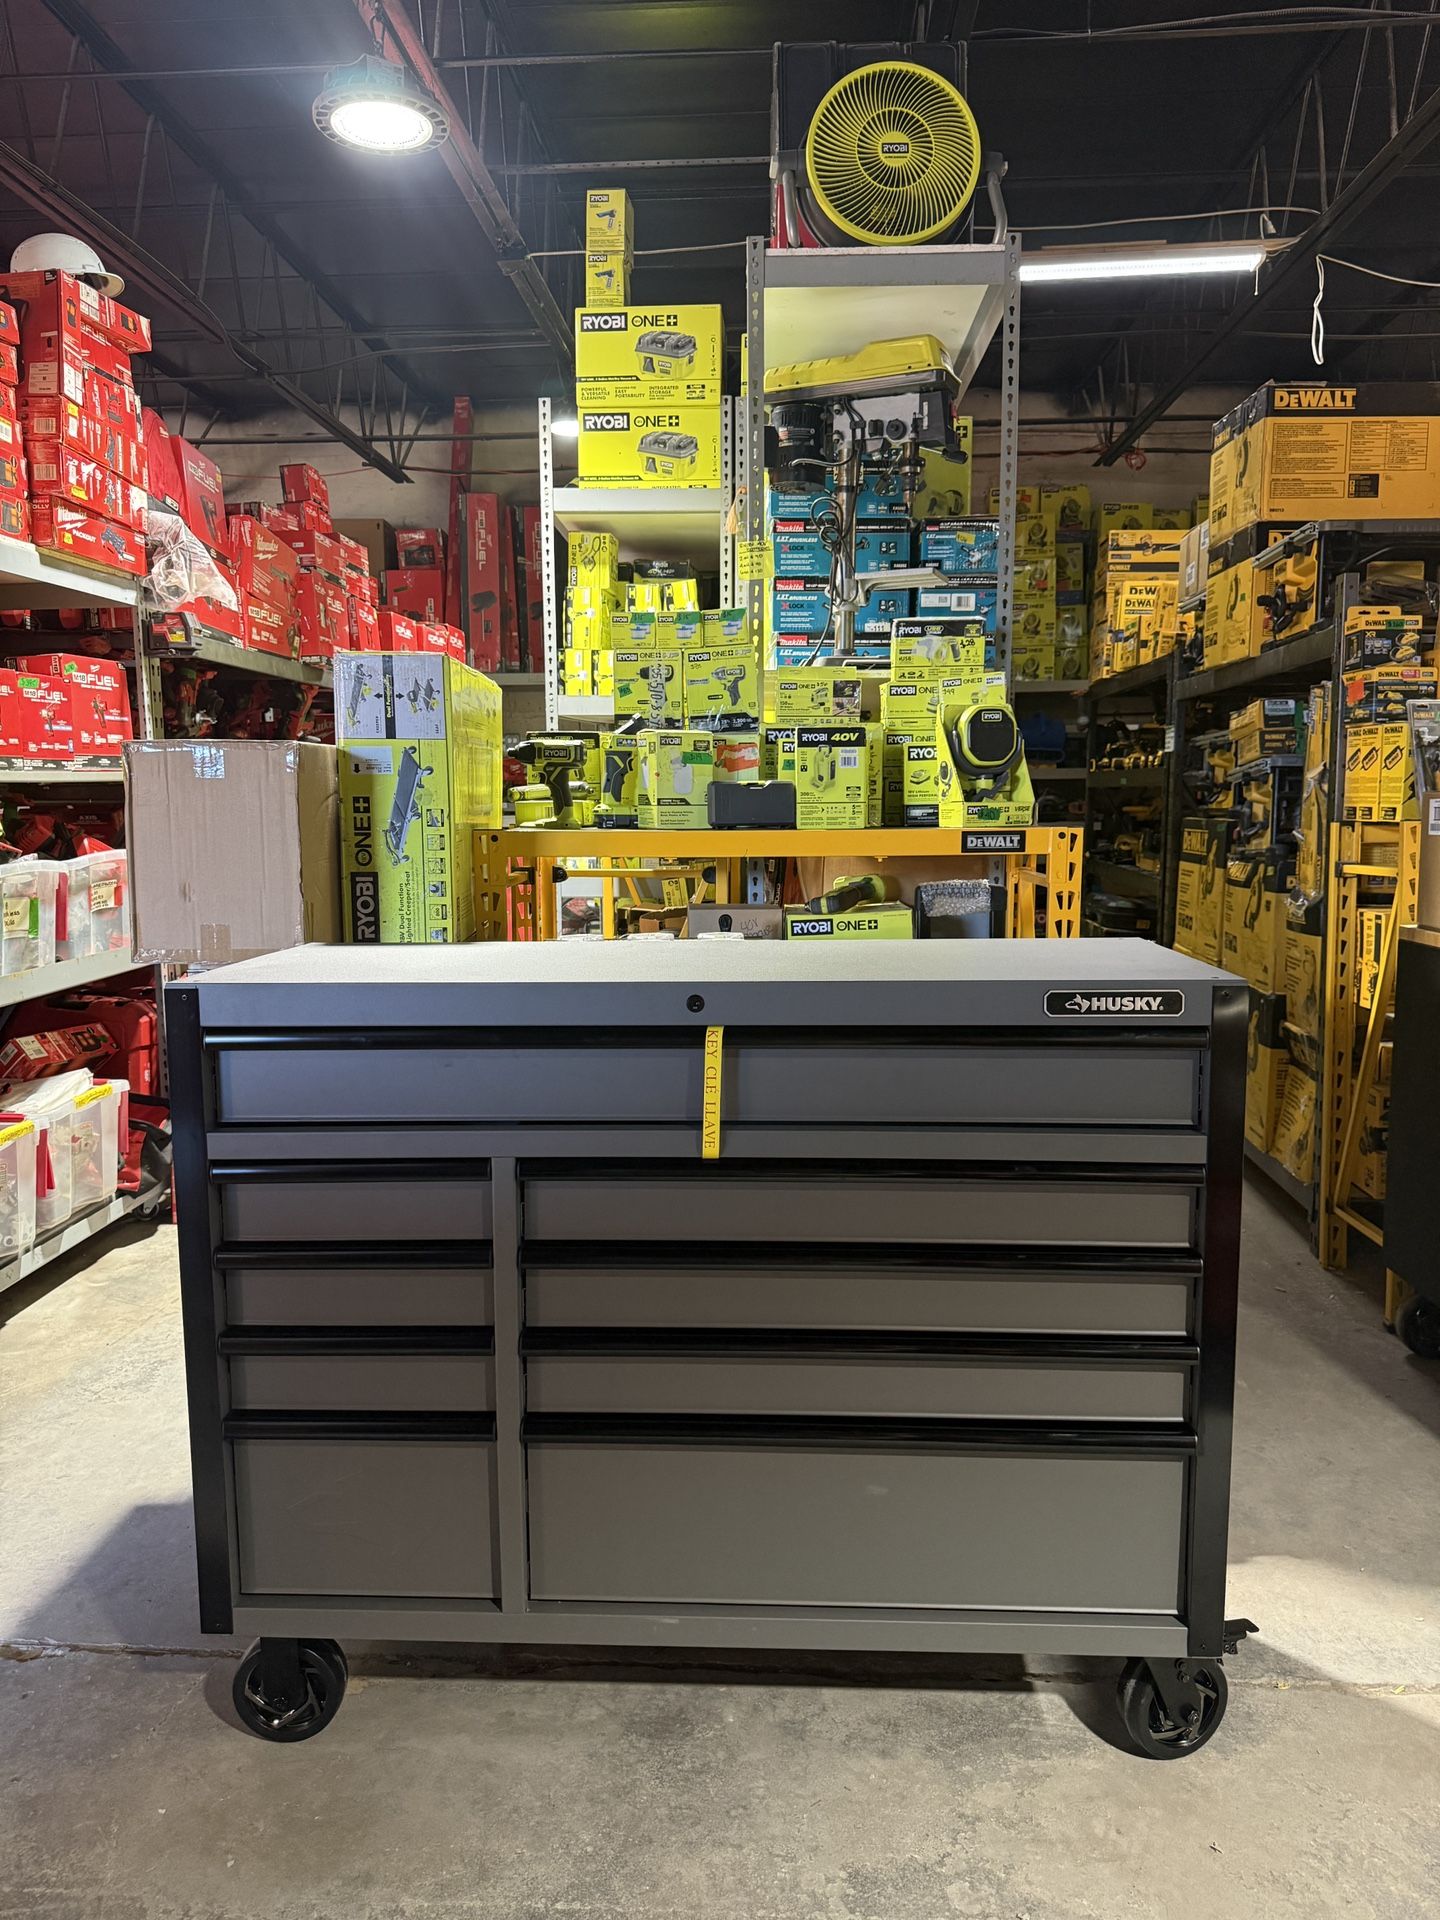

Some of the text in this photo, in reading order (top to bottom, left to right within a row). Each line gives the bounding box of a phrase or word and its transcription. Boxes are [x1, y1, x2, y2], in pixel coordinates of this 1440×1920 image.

[883, 144, 908, 153] RYOBI
[582, 315, 626, 328] RYOBI
[585, 415, 628, 429] RYOBI
[479, 530, 487, 570] FUEL
[260, 610, 283, 626] FUEL
[899, 627, 922, 635] RYOBI
[617, 653, 638, 661] RYOBI
[689, 653, 710, 661] RYOBI
[73, 673, 119, 687] M18 FUEL
[943, 680, 961, 688] RYOBI
[0, 685, 14, 694] EL
[890, 686, 916, 695] RYOBI
[37, 690, 68, 702] FUEL
[1414, 711, 1434, 719] DEWALT
[767, 731, 796, 742] RYO
[801, 733, 860, 742] RYOBI 40V
[887, 735, 912, 743] RYOBI
[544, 748, 567, 756] RYOBI
[910, 748, 937, 759] RYO
[967, 835, 1021, 848] DEWALT
[356, 876, 376, 940] RYOBI
[404, 871, 413, 943] Lighted Creeper/Seat
[792, 921, 832, 934] RYOBI
[707, 1030, 719, 1058] KEY
[704, 1102, 717, 1149] LLAVE
